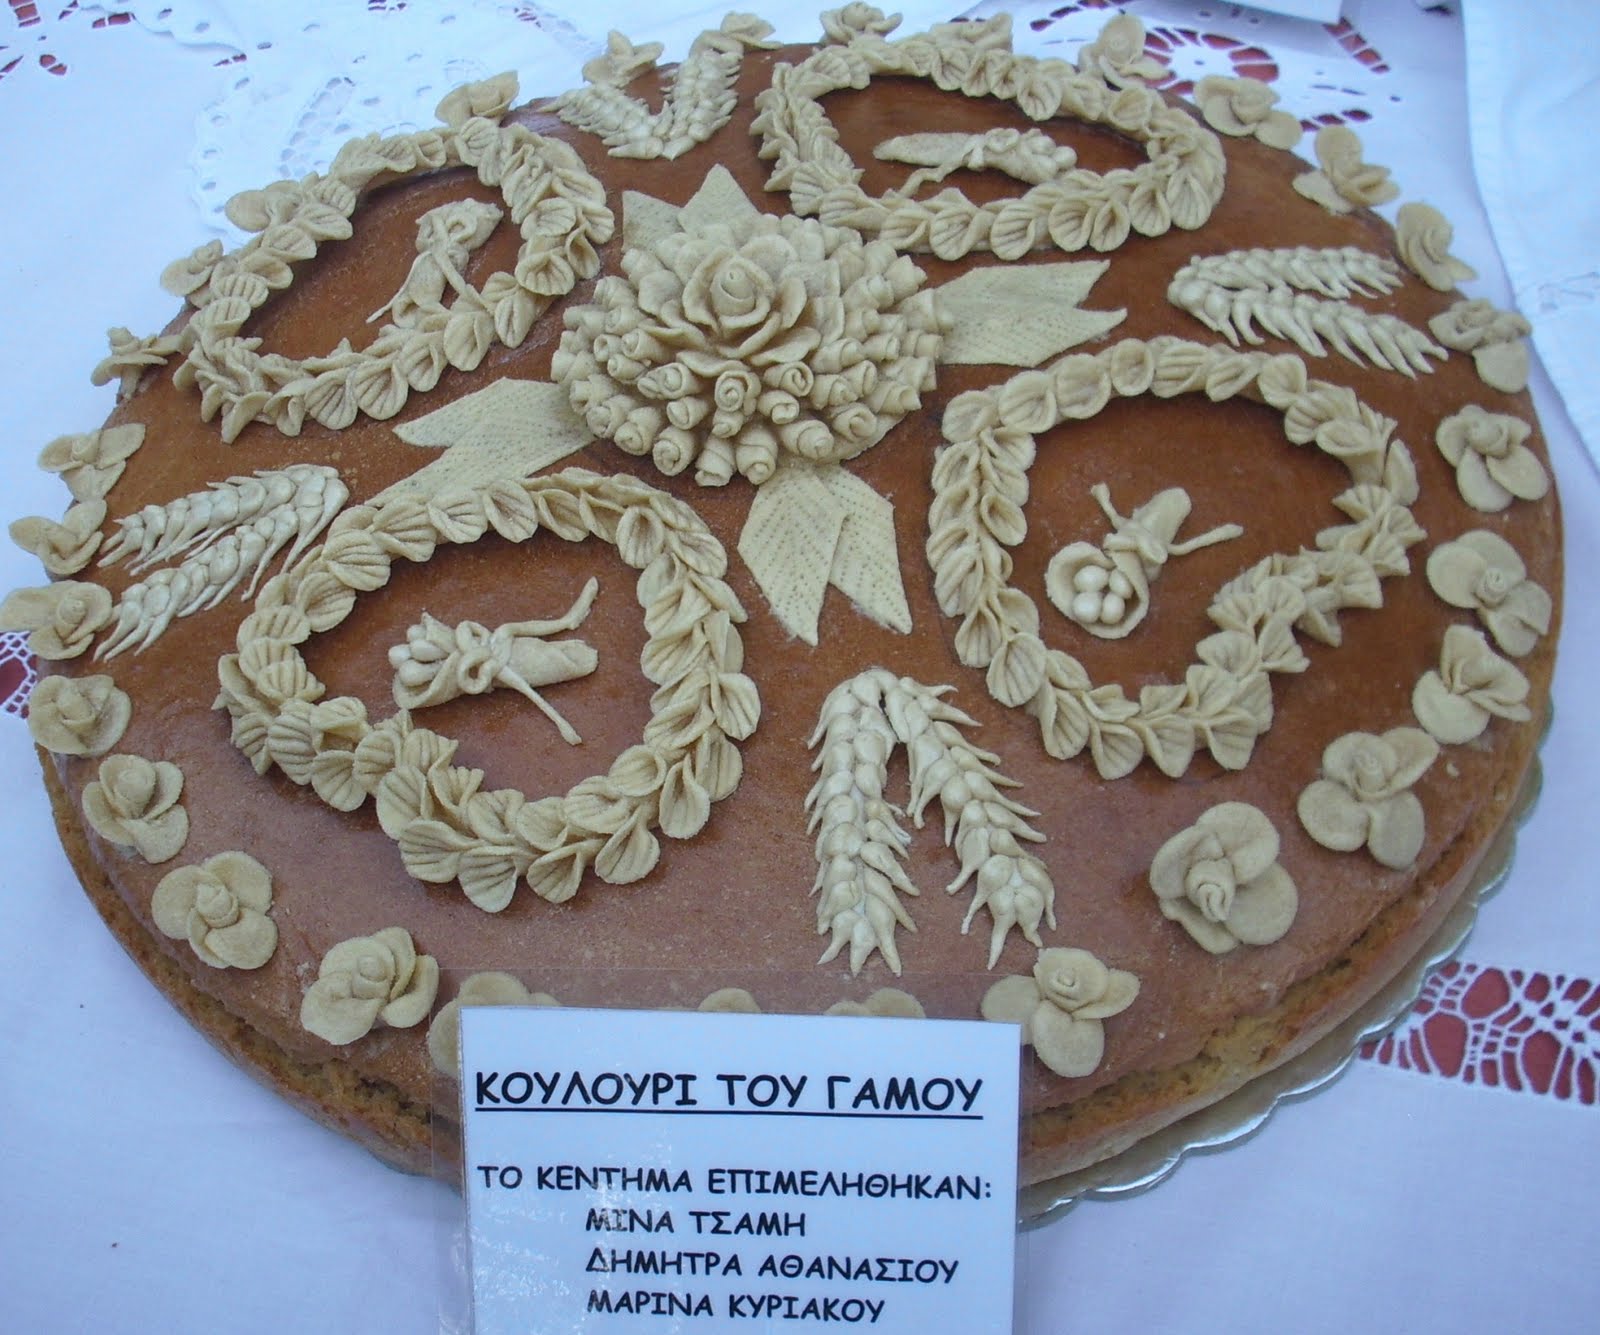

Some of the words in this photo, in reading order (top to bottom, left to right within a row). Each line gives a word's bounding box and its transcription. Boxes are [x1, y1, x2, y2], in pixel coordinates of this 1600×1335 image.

[476, 1071, 698, 1106] ΚΟΥΛΟΥΡΙ
[715, 1073, 808, 1108] ΤΟΥ
[827, 1076, 983, 1112] ΓΑΜΟΥ
[476, 1165, 523, 1190] ΤΟ
[537, 1165, 693, 1193] ΚΕΝΤΗΜΑ
[708, 1168, 992, 1200] ΕΠΙΜΕΛΗΘΗΚΑΝ:
[585, 1208, 675, 1234] ΜΙΝΑ
[688, 1211, 806, 1237] ΤΣΑΜΗ
[585, 1248, 743, 1277] ΔΗΜΗΤΡΑ
[757, 1255, 959, 1284] ΑΘΑΝΑΣΙΟΥ
[587, 1289, 714, 1317] ΜΑΡΙΝΑ
[728, 1294, 886, 1324] ΚΥΡΙΑΚΟΥ
